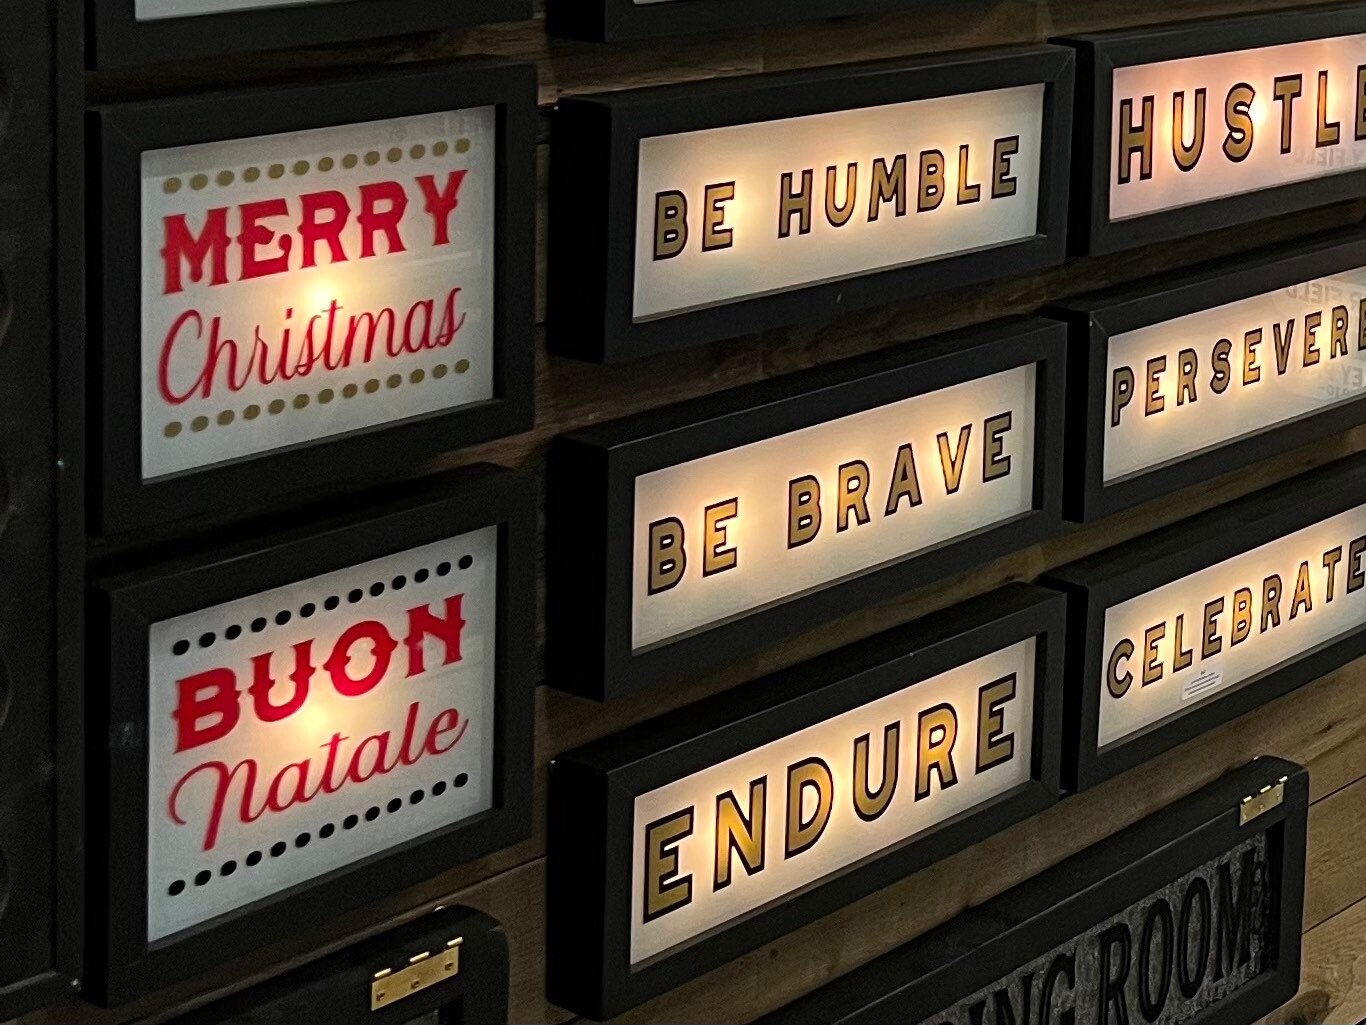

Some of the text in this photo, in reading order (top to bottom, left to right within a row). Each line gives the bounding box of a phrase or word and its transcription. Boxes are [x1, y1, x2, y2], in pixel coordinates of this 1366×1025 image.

[160, 169, 469, 296] MERRY
[652, 134, 1021, 261] BE HUMBLE
[156, 287, 467, 406] Christmas
[647, 410, 1013, 597] BE BRAVE
[171, 593, 466, 754] BUON
[167, 700, 470, 851] Natale
[642, 671, 1018, 925] ENDURE
[1097, 846, 1258, 1025] ROOM
